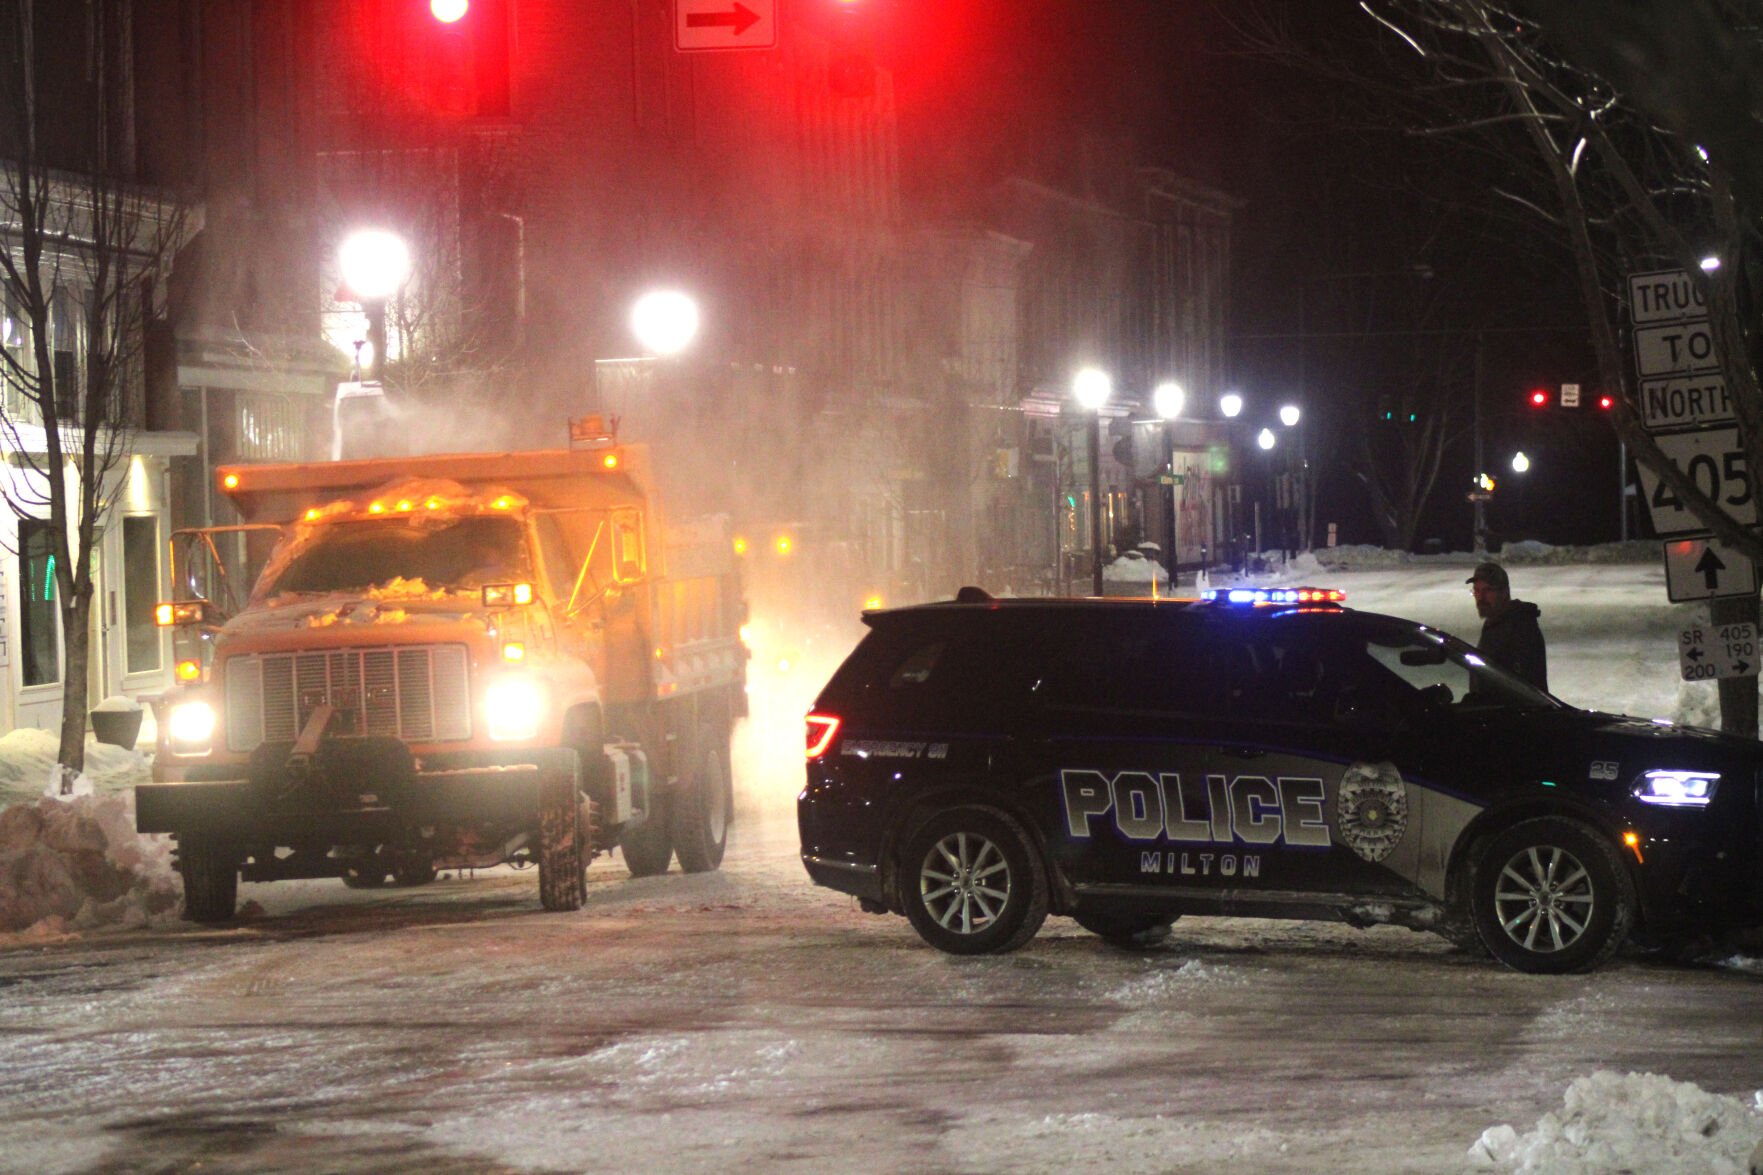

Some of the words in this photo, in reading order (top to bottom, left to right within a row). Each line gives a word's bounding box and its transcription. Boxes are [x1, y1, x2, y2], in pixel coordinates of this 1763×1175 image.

[1636, 280, 1704, 313] TRUC
[1661, 331, 1711, 363] TO
[1682, 630, 1704, 645] SR
[1720, 624, 1752, 641] 405
[1726, 642, 1753, 659] 190
[1685, 663, 1716, 680] 200
[1588, 760, 1620, 781] 25
[1060, 769, 1332, 847] POLICE
[1140, 851, 1261, 878] MILTON
